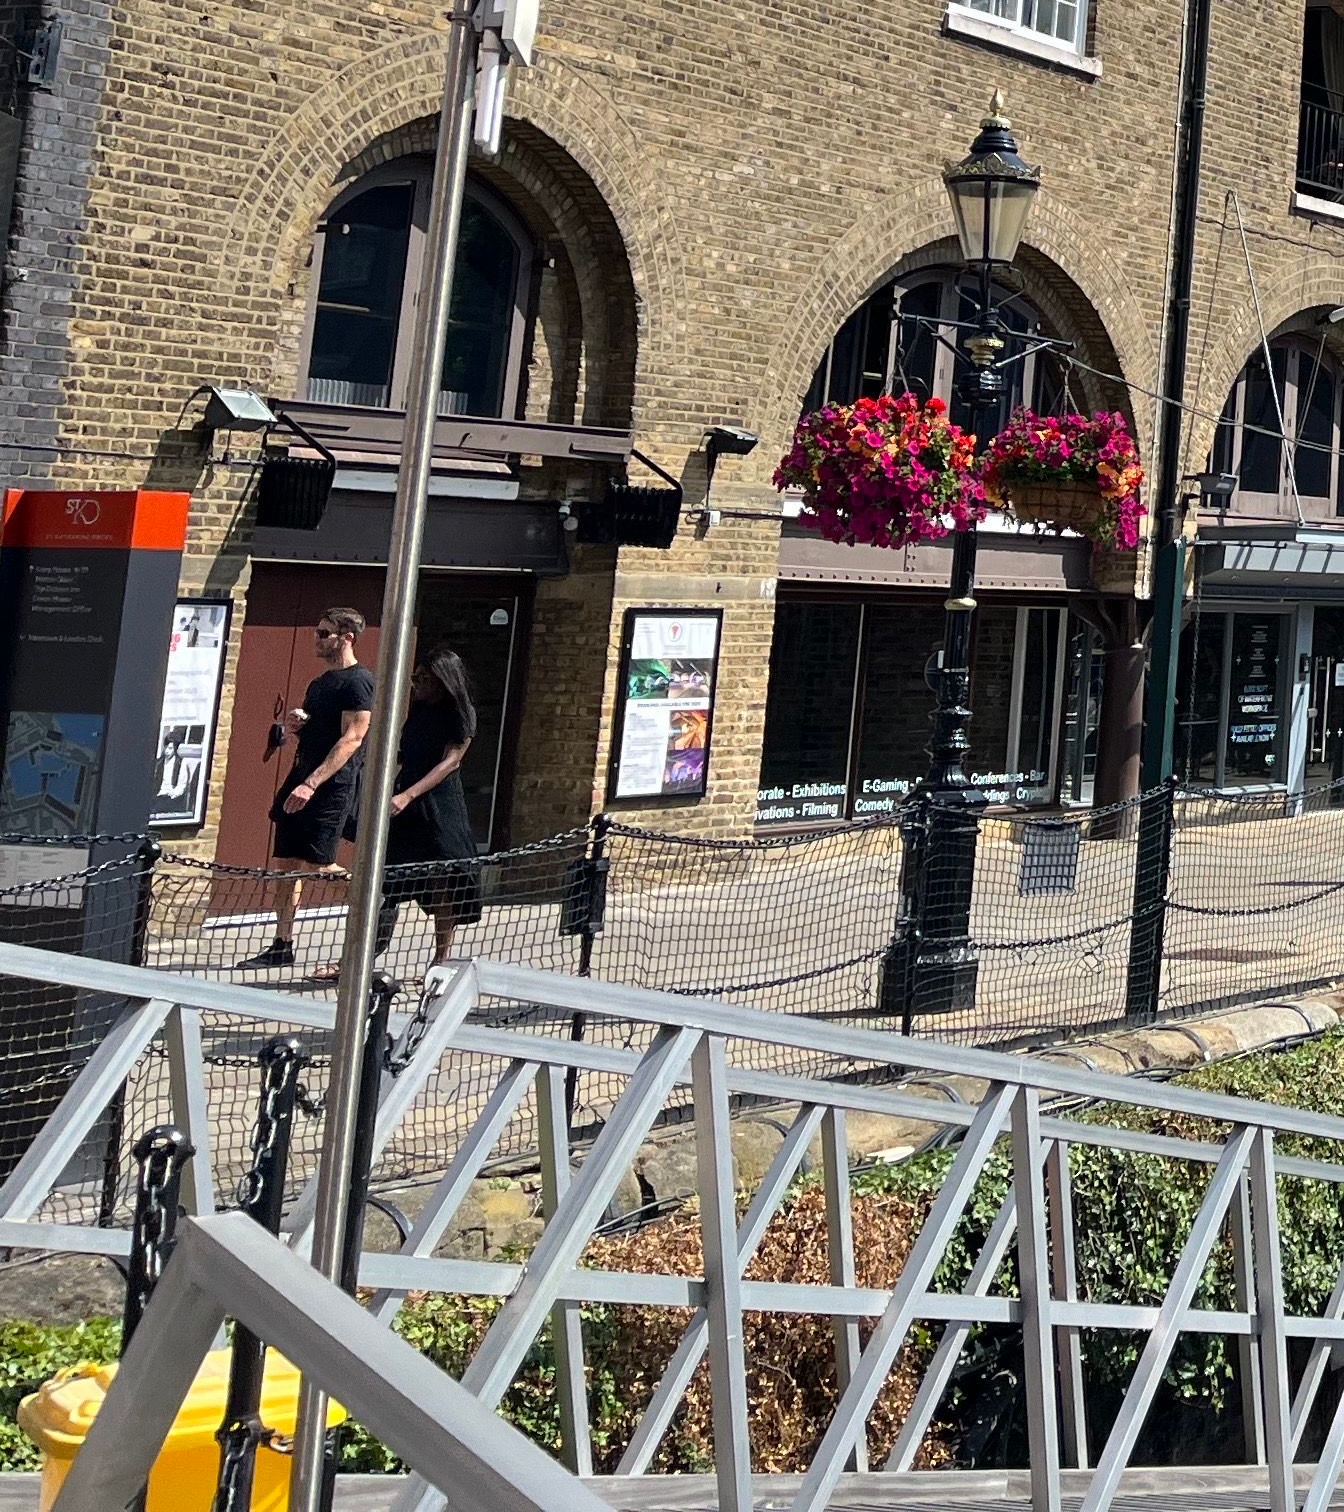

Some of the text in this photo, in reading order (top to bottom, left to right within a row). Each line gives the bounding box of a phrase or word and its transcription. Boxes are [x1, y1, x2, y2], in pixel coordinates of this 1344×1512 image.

[970, 771, 1024, 785] Conferences
[1030, 770, 1046, 781] Bar
[792, 782, 847, 798] Exhibitions
[862, 778, 909, 793] E-Gaming
[802, 801, 839, 817] Filming
[854, 797, 895, 812] Comedy
